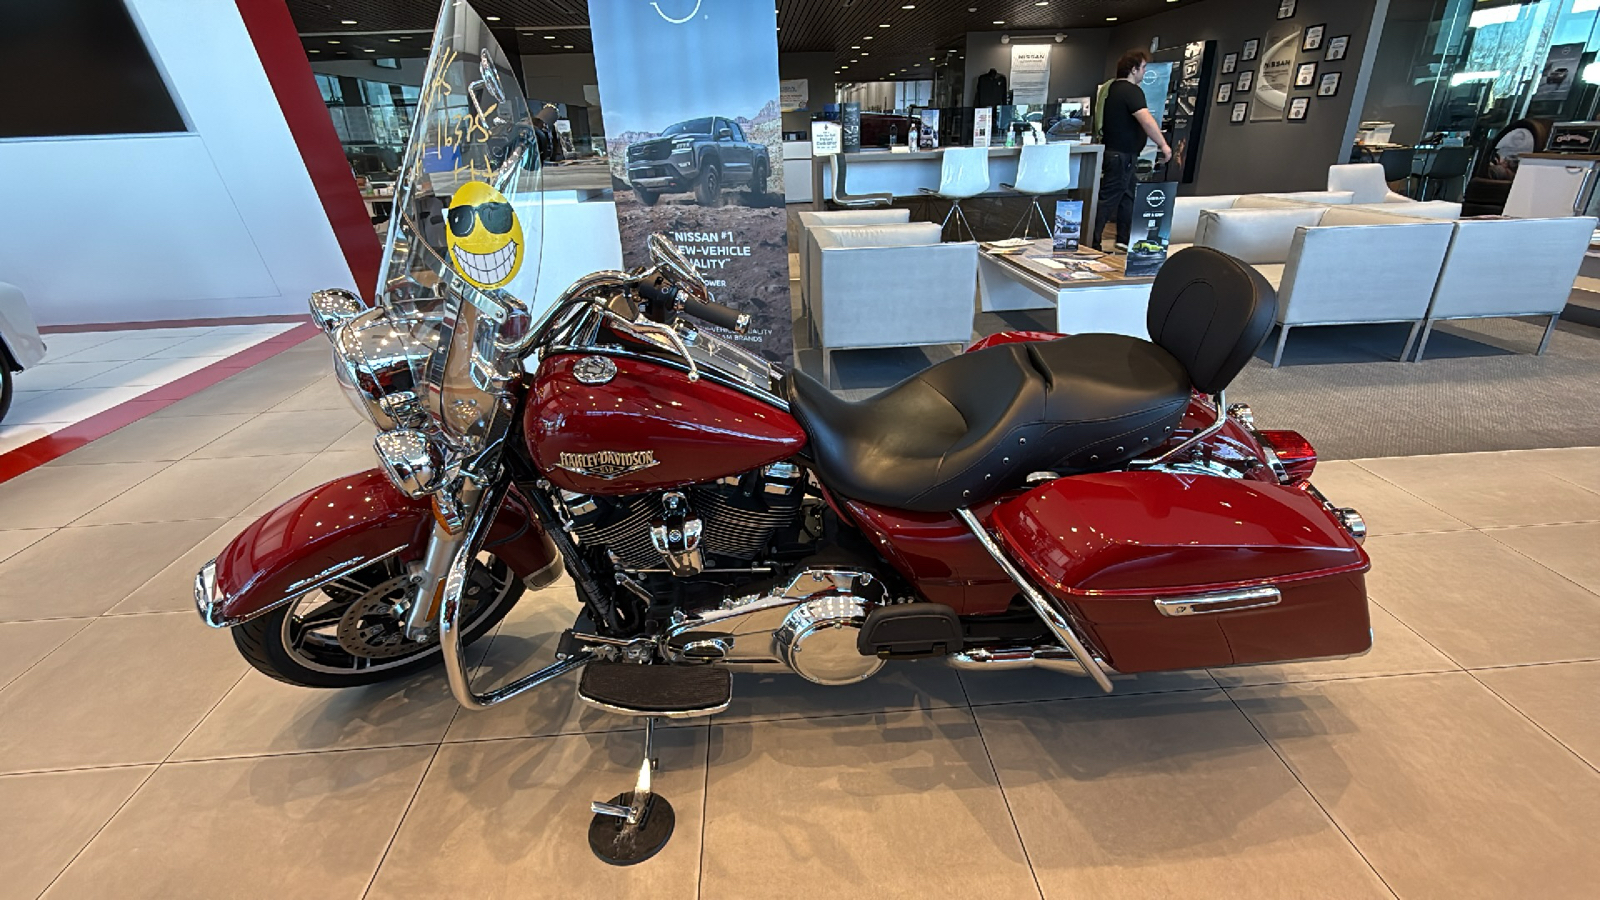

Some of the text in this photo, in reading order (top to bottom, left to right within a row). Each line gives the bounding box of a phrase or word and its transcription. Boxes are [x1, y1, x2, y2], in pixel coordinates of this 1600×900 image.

[1264, 60, 1291, 68] NISSAN
[721, 231, 734, 243] #1
[675, 245, 751, 256] EW-VEHICLE
[748, 328, 773, 336] UALITY
[734, 335, 763, 343] BRANDS
[559, 450, 654, 469] HARLEY-DAVIDSON
